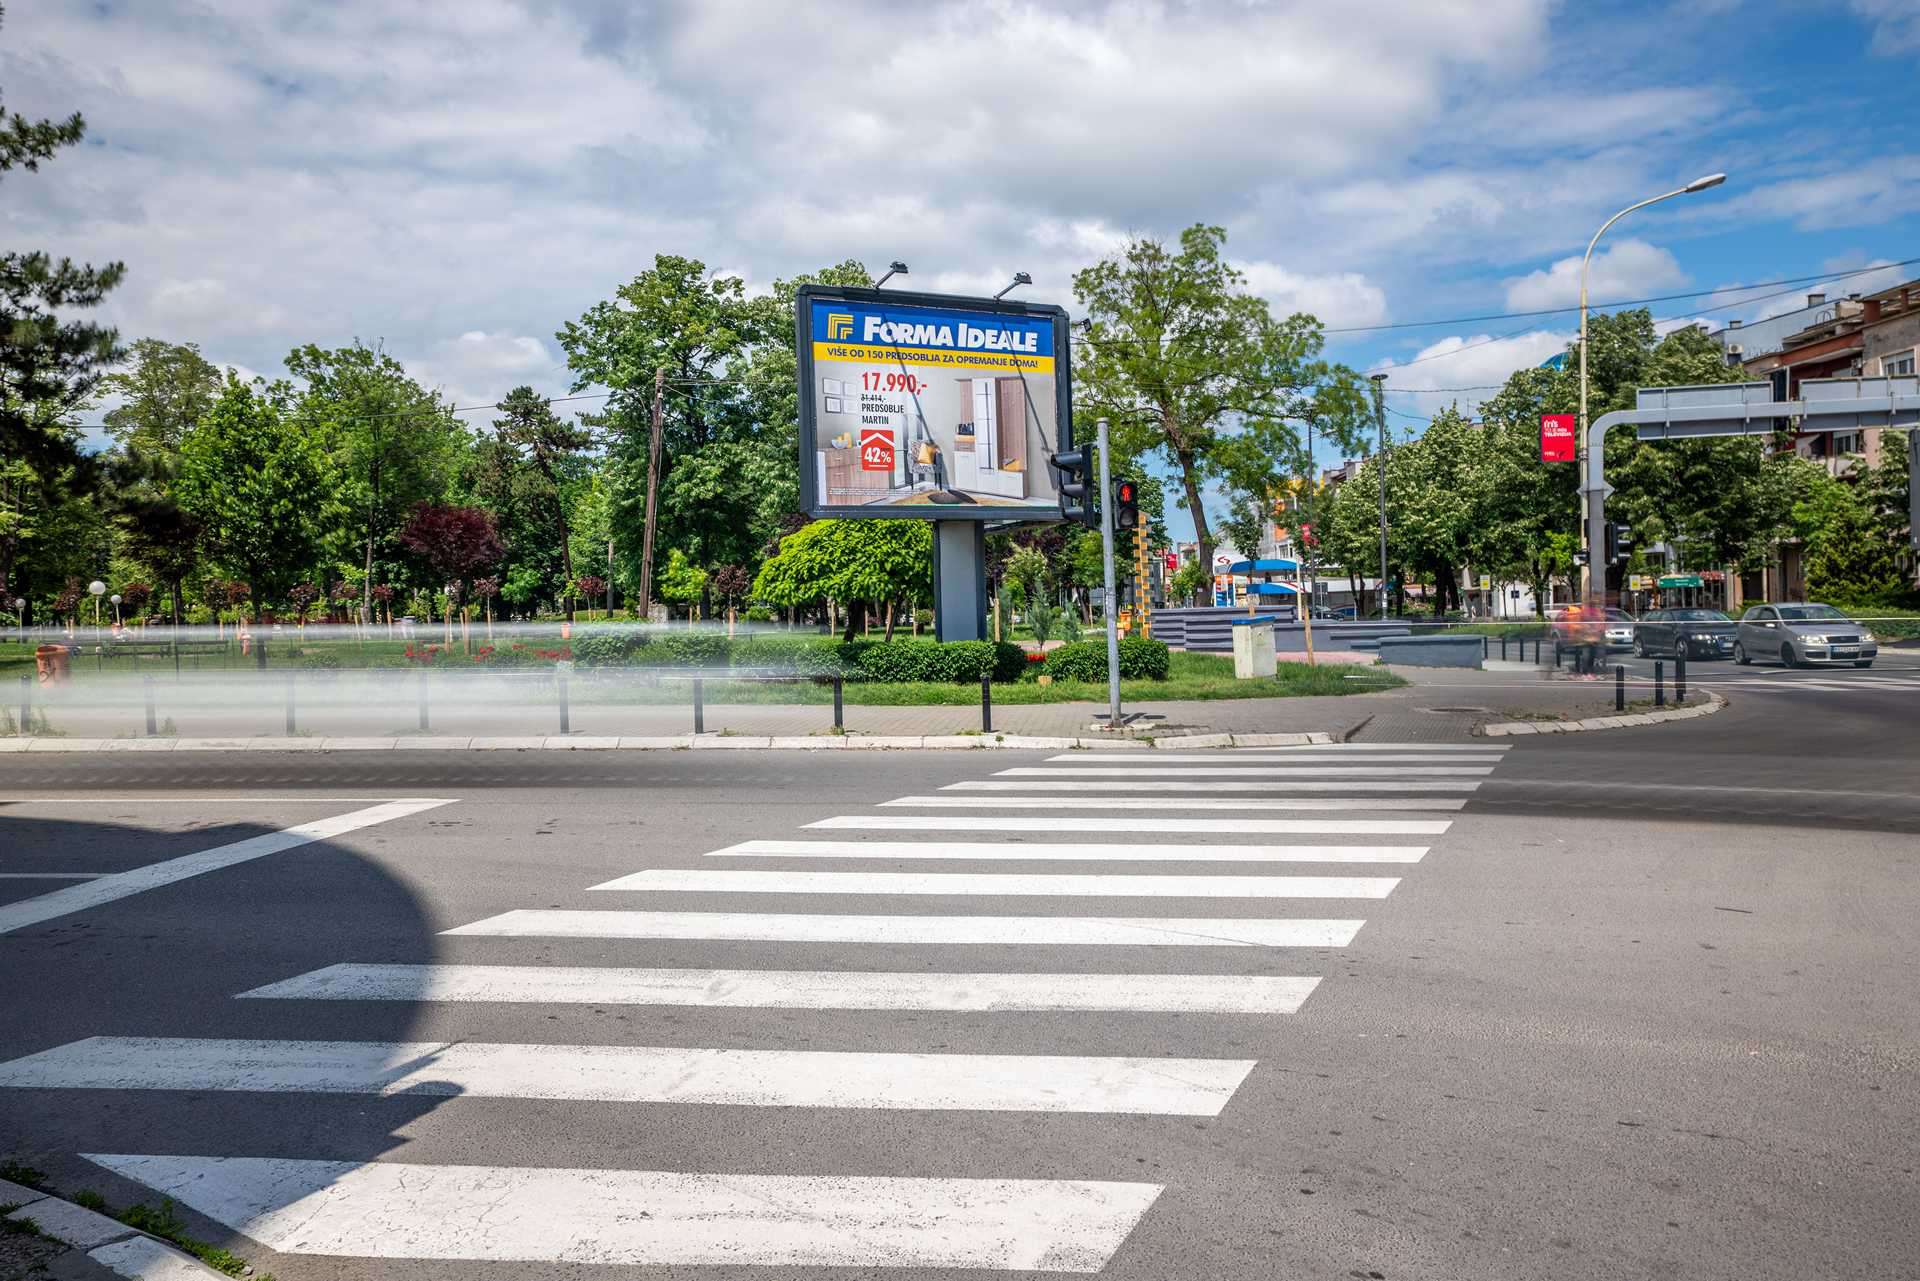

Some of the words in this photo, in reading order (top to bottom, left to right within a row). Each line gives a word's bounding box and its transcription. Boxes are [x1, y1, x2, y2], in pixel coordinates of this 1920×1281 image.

[863, 316, 954, 347] FORMA
[957, 323, 1039, 353] IDEALE
[827, 346, 847, 357] VIŠE
[849, 349, 864, 358] OD
[867, 350, 883, 359] 150
[885, 351, 941, 363] PREDSOBLJA
[942, 354, 954, 363] ZA
[956, 355, 1008, 366] OPREMANJE
[1009, 358, 1039, 368] DOMA!
[861, 403, 905, 414] PREDSOBLJE
[862, 415, 889, 425] MARTIN
[864, 447, 892, 463] 42%
